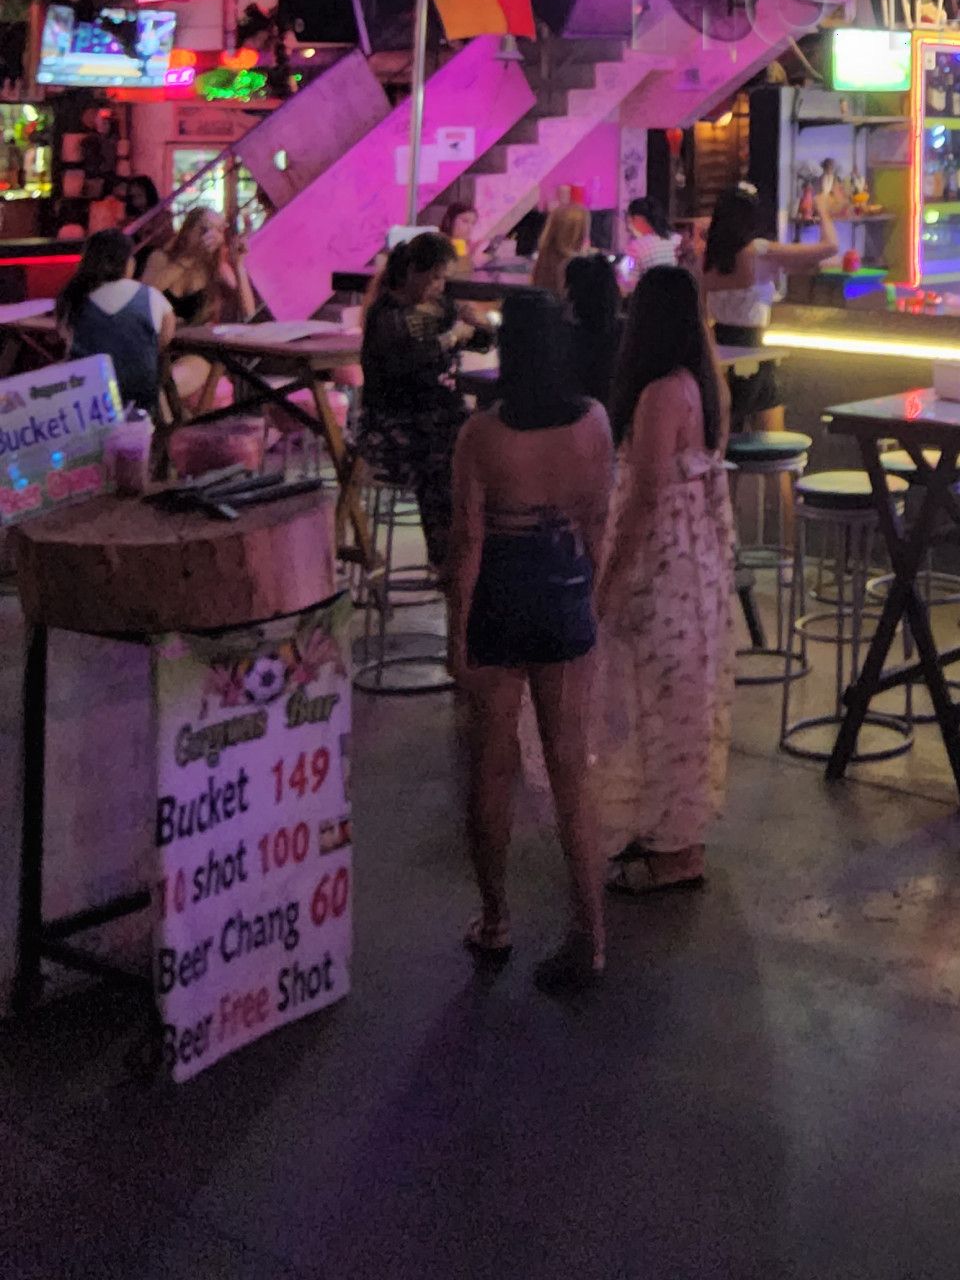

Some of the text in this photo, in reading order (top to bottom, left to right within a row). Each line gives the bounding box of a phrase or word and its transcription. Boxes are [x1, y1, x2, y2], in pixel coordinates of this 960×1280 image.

[155, 746, 331, 847] Bucket 149
[193, 839, 248, 904] shot
[258, 820, 311, 876] 100
[158, 865, 349, 995] Beer Chang 60
[162, 1014, 213, 1072] Beer
[277, 950, 334, 1013] Shot
